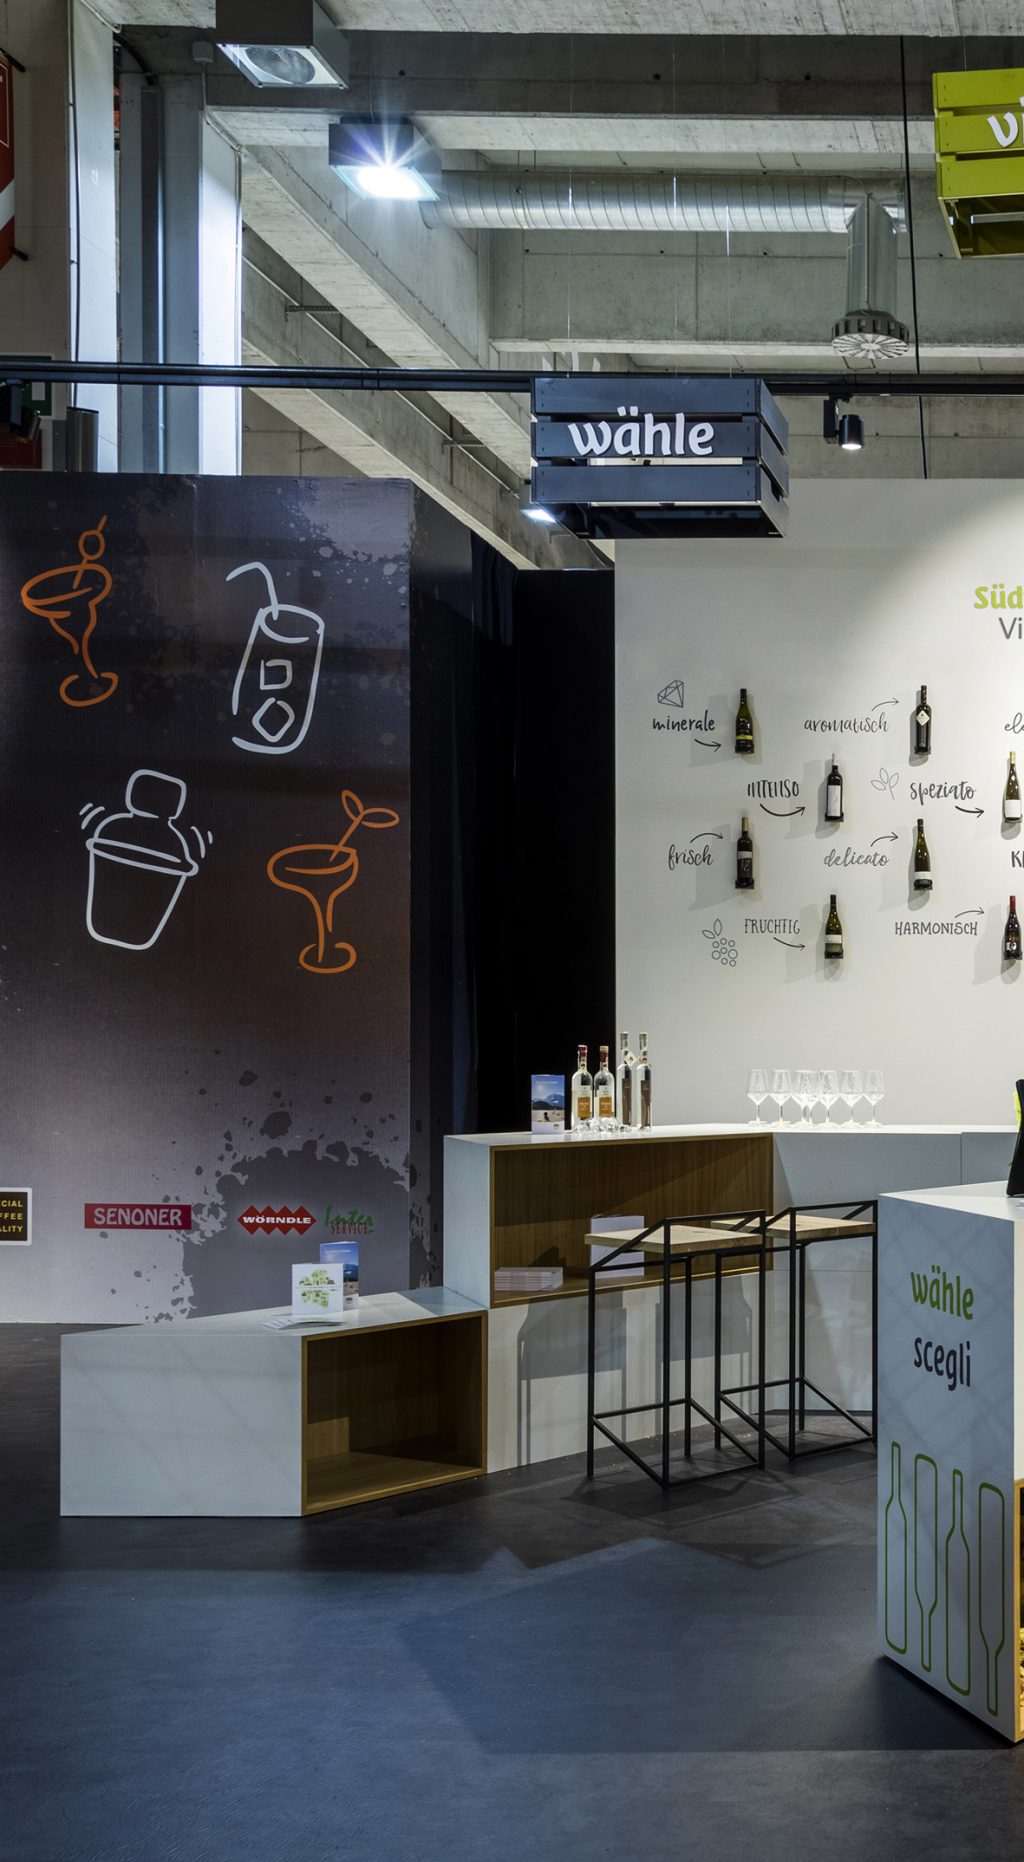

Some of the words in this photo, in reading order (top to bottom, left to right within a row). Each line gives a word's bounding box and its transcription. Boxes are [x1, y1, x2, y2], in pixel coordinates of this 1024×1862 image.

[568, 406, 715, 456] wähle
[652, 709, 715, 732] minerale
[804, 712, 890, 733] aromatisch
[910, 781, 976, 806] speziato
[668, 844, 713, 871] frisch
[824, 847, 889, 867] delicato
[744, 918, 800, 935] FRUCHTIG
[895, 921, 978, 936] HARMONISCH
[94, 1207, 182, 1226] SENONER
[242, 1215, 312, 1224] WÖRNDLE
[0, 1225, 23, 1233] LITY
[330, 1221, 368, 1235] SERVICE
[910, 1265, 974, 1320] wähle
[914, 1337, 971, 1391] scegli
